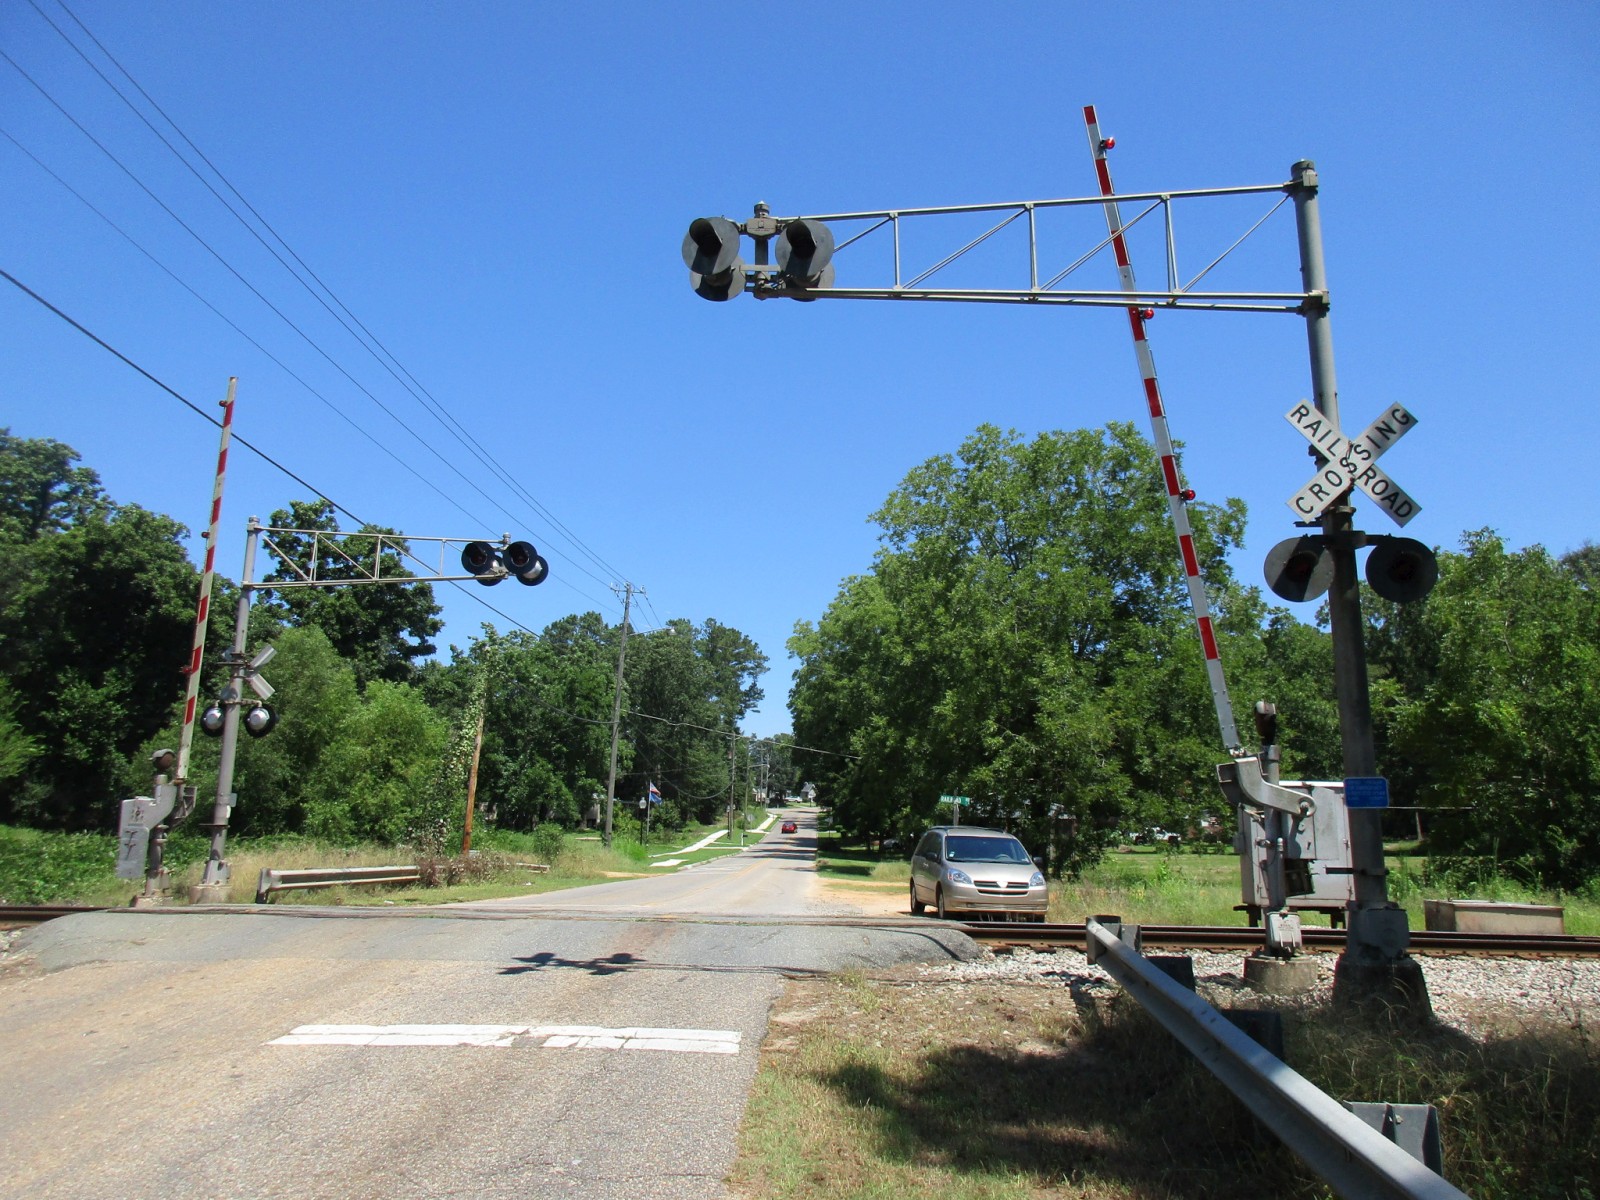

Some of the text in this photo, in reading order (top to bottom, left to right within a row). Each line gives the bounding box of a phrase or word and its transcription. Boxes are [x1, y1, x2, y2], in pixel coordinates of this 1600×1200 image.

[1290, 404, 1413, 518] RAIL ROAD
[1295, 408, 1410, 514] CROSSING
